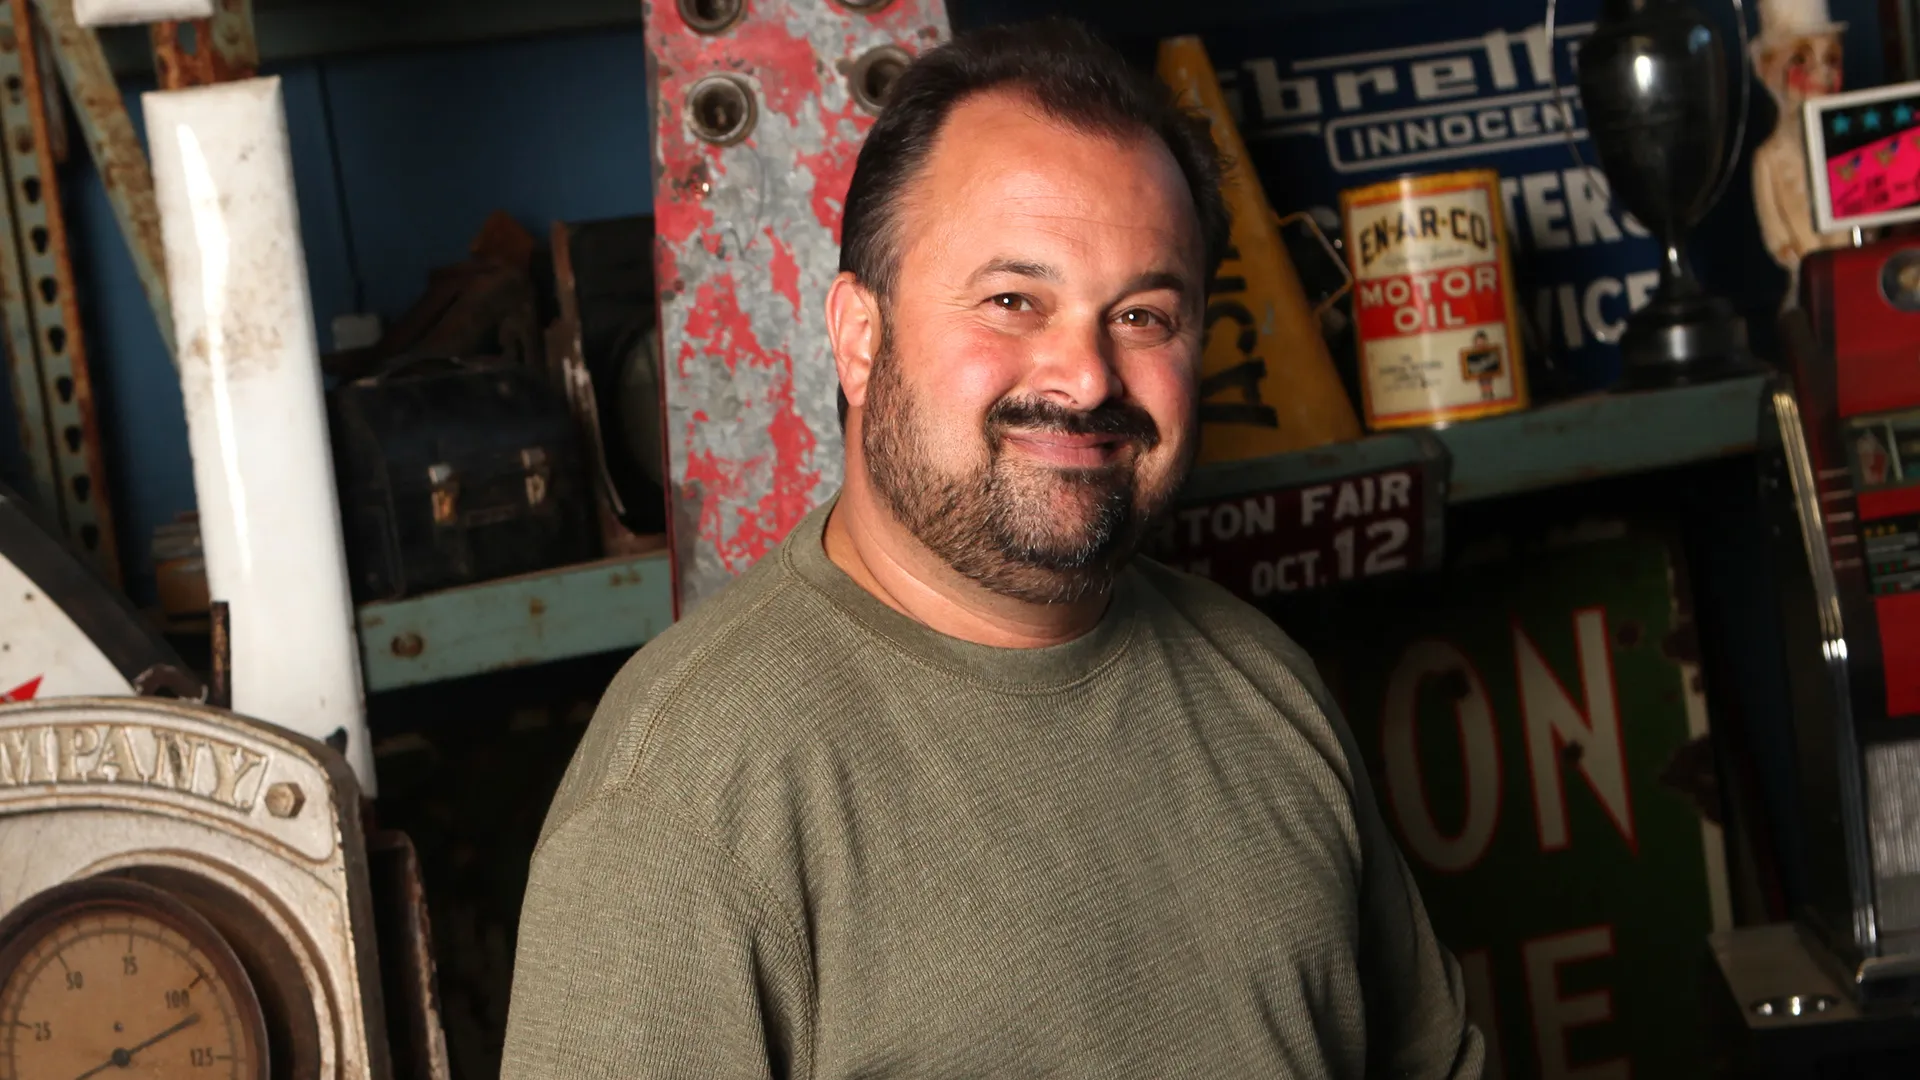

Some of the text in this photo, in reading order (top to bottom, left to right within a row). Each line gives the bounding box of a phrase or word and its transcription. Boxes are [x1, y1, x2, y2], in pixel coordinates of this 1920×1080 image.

[1351, 100, 1581, 158] INNOCEN
[1360, 266, 1497, 309] MOTOR
[1393, 302, 1466, 332] OIL
[1300, 471, 1412, 527] FAIR
[1251, 517, 1410, 597] OCT. 12
[1381, 606, 1638, 875] ON
[66, 971, 83, 991] 50
[165, 988, 190, 1009] 100
[35, 1022, 51, 1040] 25
